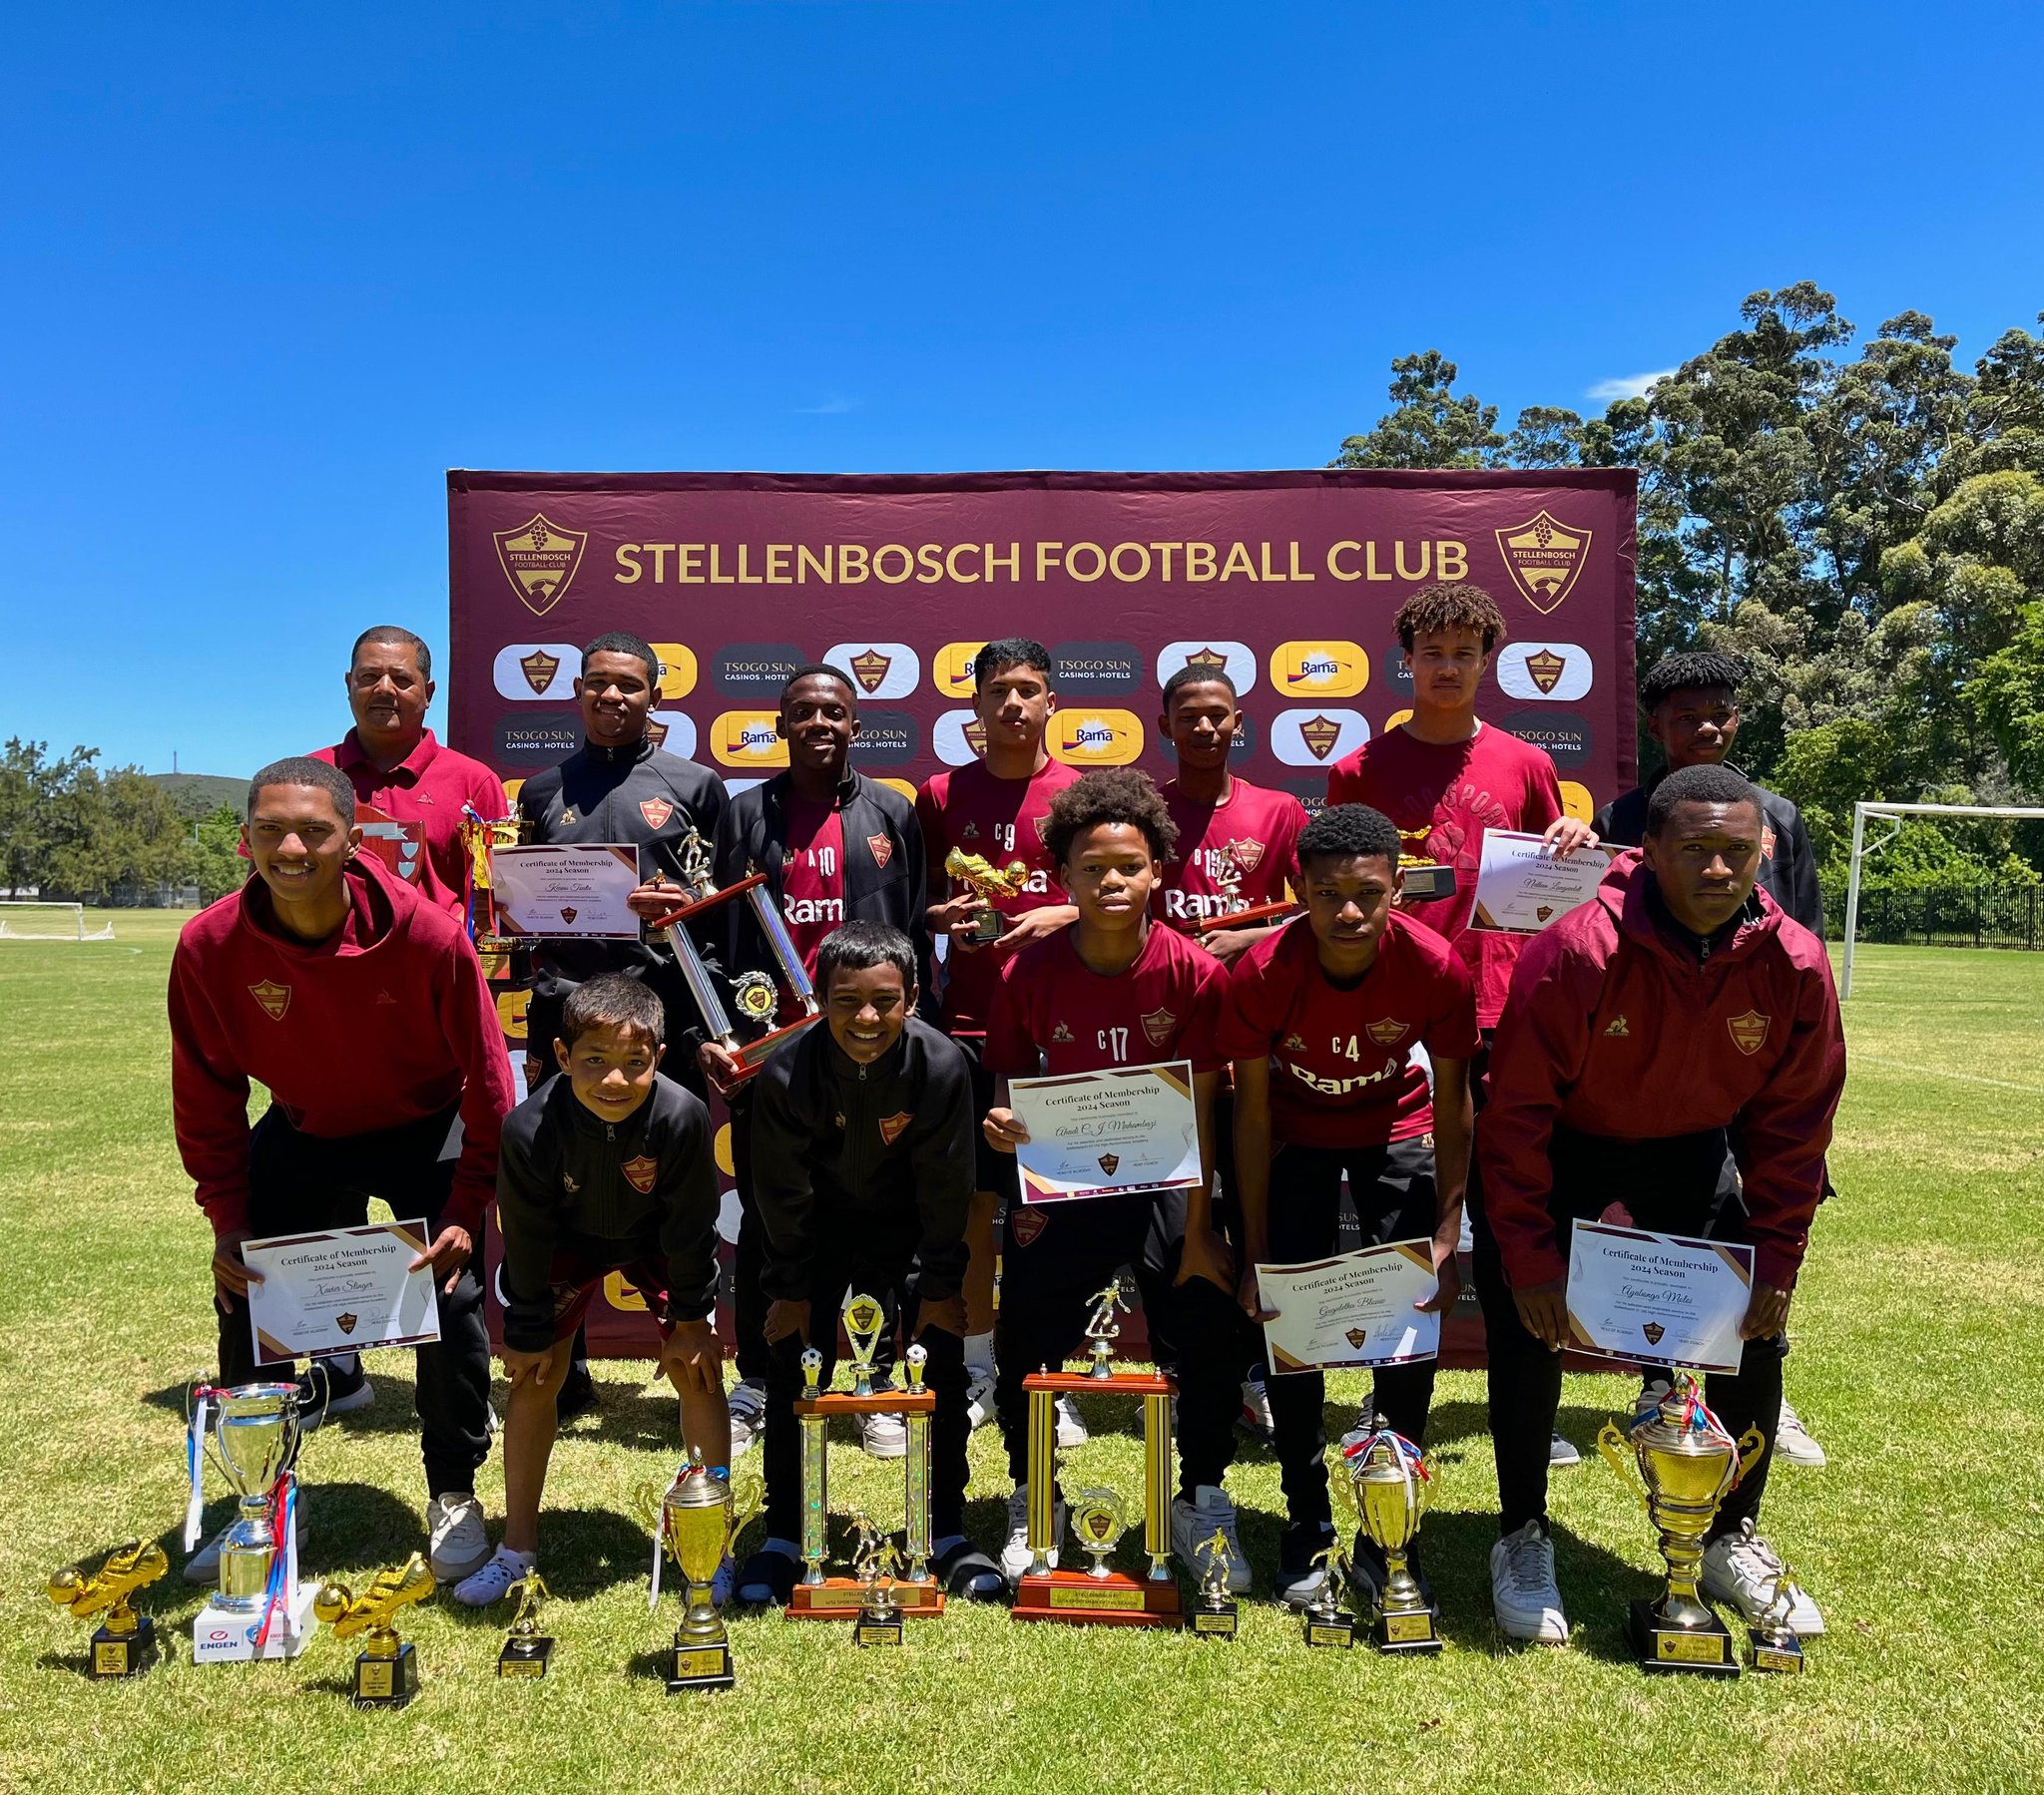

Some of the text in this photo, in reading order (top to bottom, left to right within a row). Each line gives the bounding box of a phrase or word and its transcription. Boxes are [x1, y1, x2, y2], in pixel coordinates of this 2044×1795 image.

[614, 539, 1469, 585] STELLENBOSCH FOOTBALL CLUB
[724, 662, 796, 673] TSOGO SUN
[1058, 660, 1131, 671] TSOGO SUN
[1301, 662, 1338, 673] Rama
[505, 730, 575, 740] TSOGO SUN
[741, 730, 777, 743] Rama
[882, 729, 907, 739] SUN
[1076, 728, 1113, 741] Rama
[1511, 730, 1582, 741] TSOGO SUN
[994, 823, 1016, 852] C 9
[808, 846, 834, 877] A 10
[1194, 848, 1202, 866] B
[1511, 850, 1550, 861] Certificate
[1560, 856, 1605, 869] Membership
[1554, 864, 1579, 873] Season
[783, 894, 844, 925] Ram
[1097, 1027, 1129, 1062] C 17
[1331, 1035, 1360, 1063] C 4
[1045, 1086, 1161, 1107] Certificate of Membership
[1099, 1100, 1131, 1110] Season
[280, 1254, 328, 1266] Certificate
[340, 1244, 397, 1259] Membership
[1603, 1247, 1719, 1273] Certificate of Membership
[313, 1259, 367, 1272] 2024 Season
[1630, 1263, 1686, 1278] 2024 Season
[1291, 1262, 1403, 1292] Certificate of Membership
[1323, 1277, 1374, 1295] 2024 Season
